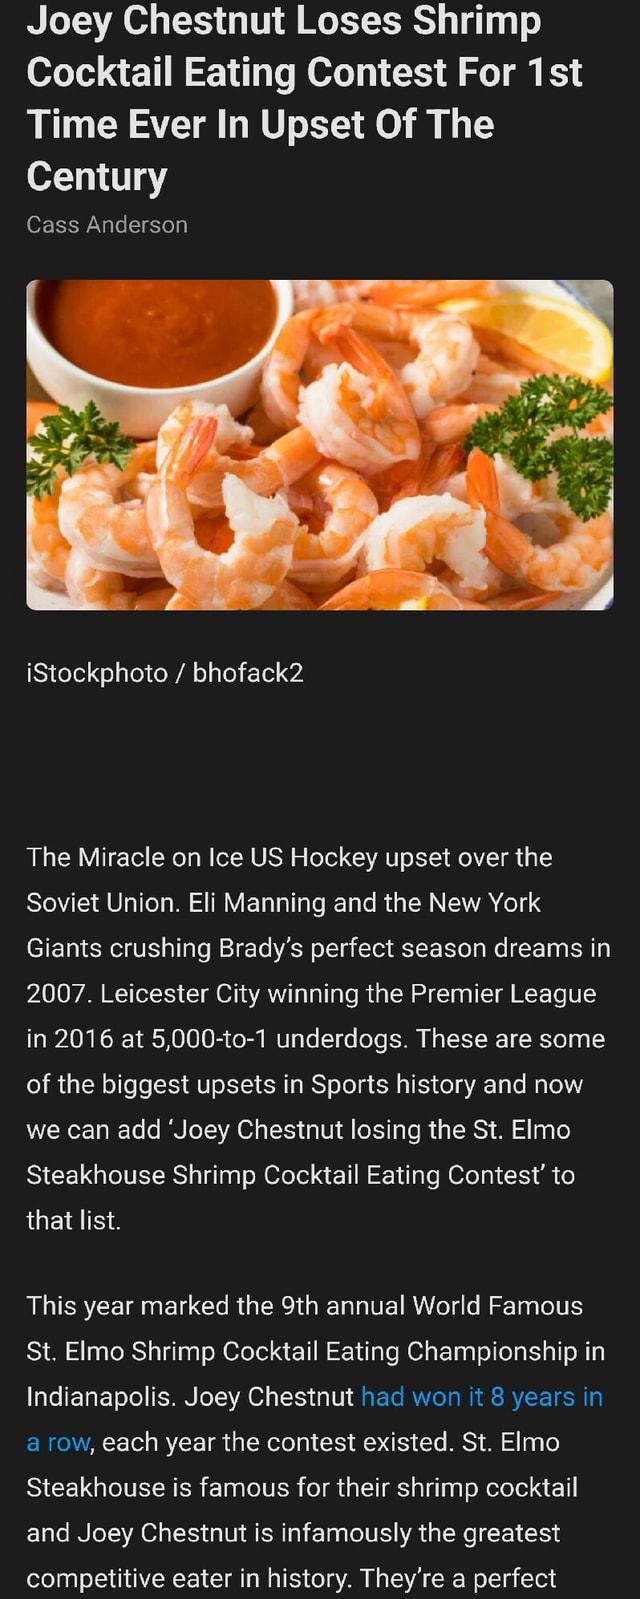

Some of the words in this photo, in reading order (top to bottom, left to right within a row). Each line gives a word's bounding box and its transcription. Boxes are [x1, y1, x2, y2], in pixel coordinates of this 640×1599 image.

[26, 4, 114, 44] Joey
[123, 2, 286, 36] Chestnut
[297, 4, 402, 36] Loses
[413, 2, 542, 43] Shrimp
[26, 54, 173, 88] Cocktail
[185, 55, 296, 96] Eating
[307, 55, 448, 88] Contest
[458, 56, 517, 88] For
[528, 56, 584, 88] 1st
[26, 107, 118, 140] Time
[129, 108, 207, 140] Ever
[218, 108, 249, 139] In
[261, 108, 365, 147] Upset
[375, 106, 418, 140] Of
[425, 106, 495, 140] The
[26, 159, 169, 200] Century
[26, 215, 80, 234] Cass
[85, 214, 188, 234] Anderson
[27, 660, 169, 689] iStockphoto
[175, 663, 185, 684] /
[193, 660, 304, 684] bhofack2
[26, 982, 93, 1004] 2007.
[101, 982, 210, 1004] Leicester
[216, 982, 261, 1009] City
[267, 982, 359, 1009] winning
[364, 981, 404, 1004] the
[411, 982, 504, 1004] Premier
[510, 983, 597, 1009] League
[25, 1293, 77, 1316] This
[83, 1300, 135, 1322] year
[141, 1293, 229, 1316] marked
[235, 1293, 274, 1316] the
[281, 1293, 319, 1316] 9th
[326, 1293, 405, 1316] annual
[412, 1293, 481, 1316] World
[489, 1295, 584, 1316] Famous
[26, 1475, 166, 1498] Steakhouse
[173, 1476, 192, 1498] is
[199, 1475, 290, 1498] famous
[296, 1475, 331, 1498] for
[335, 1475, 391, 1498] their
[396, 1475, 479, 1503] shrimp
[486, 1475, 578, 1498] cocktail
